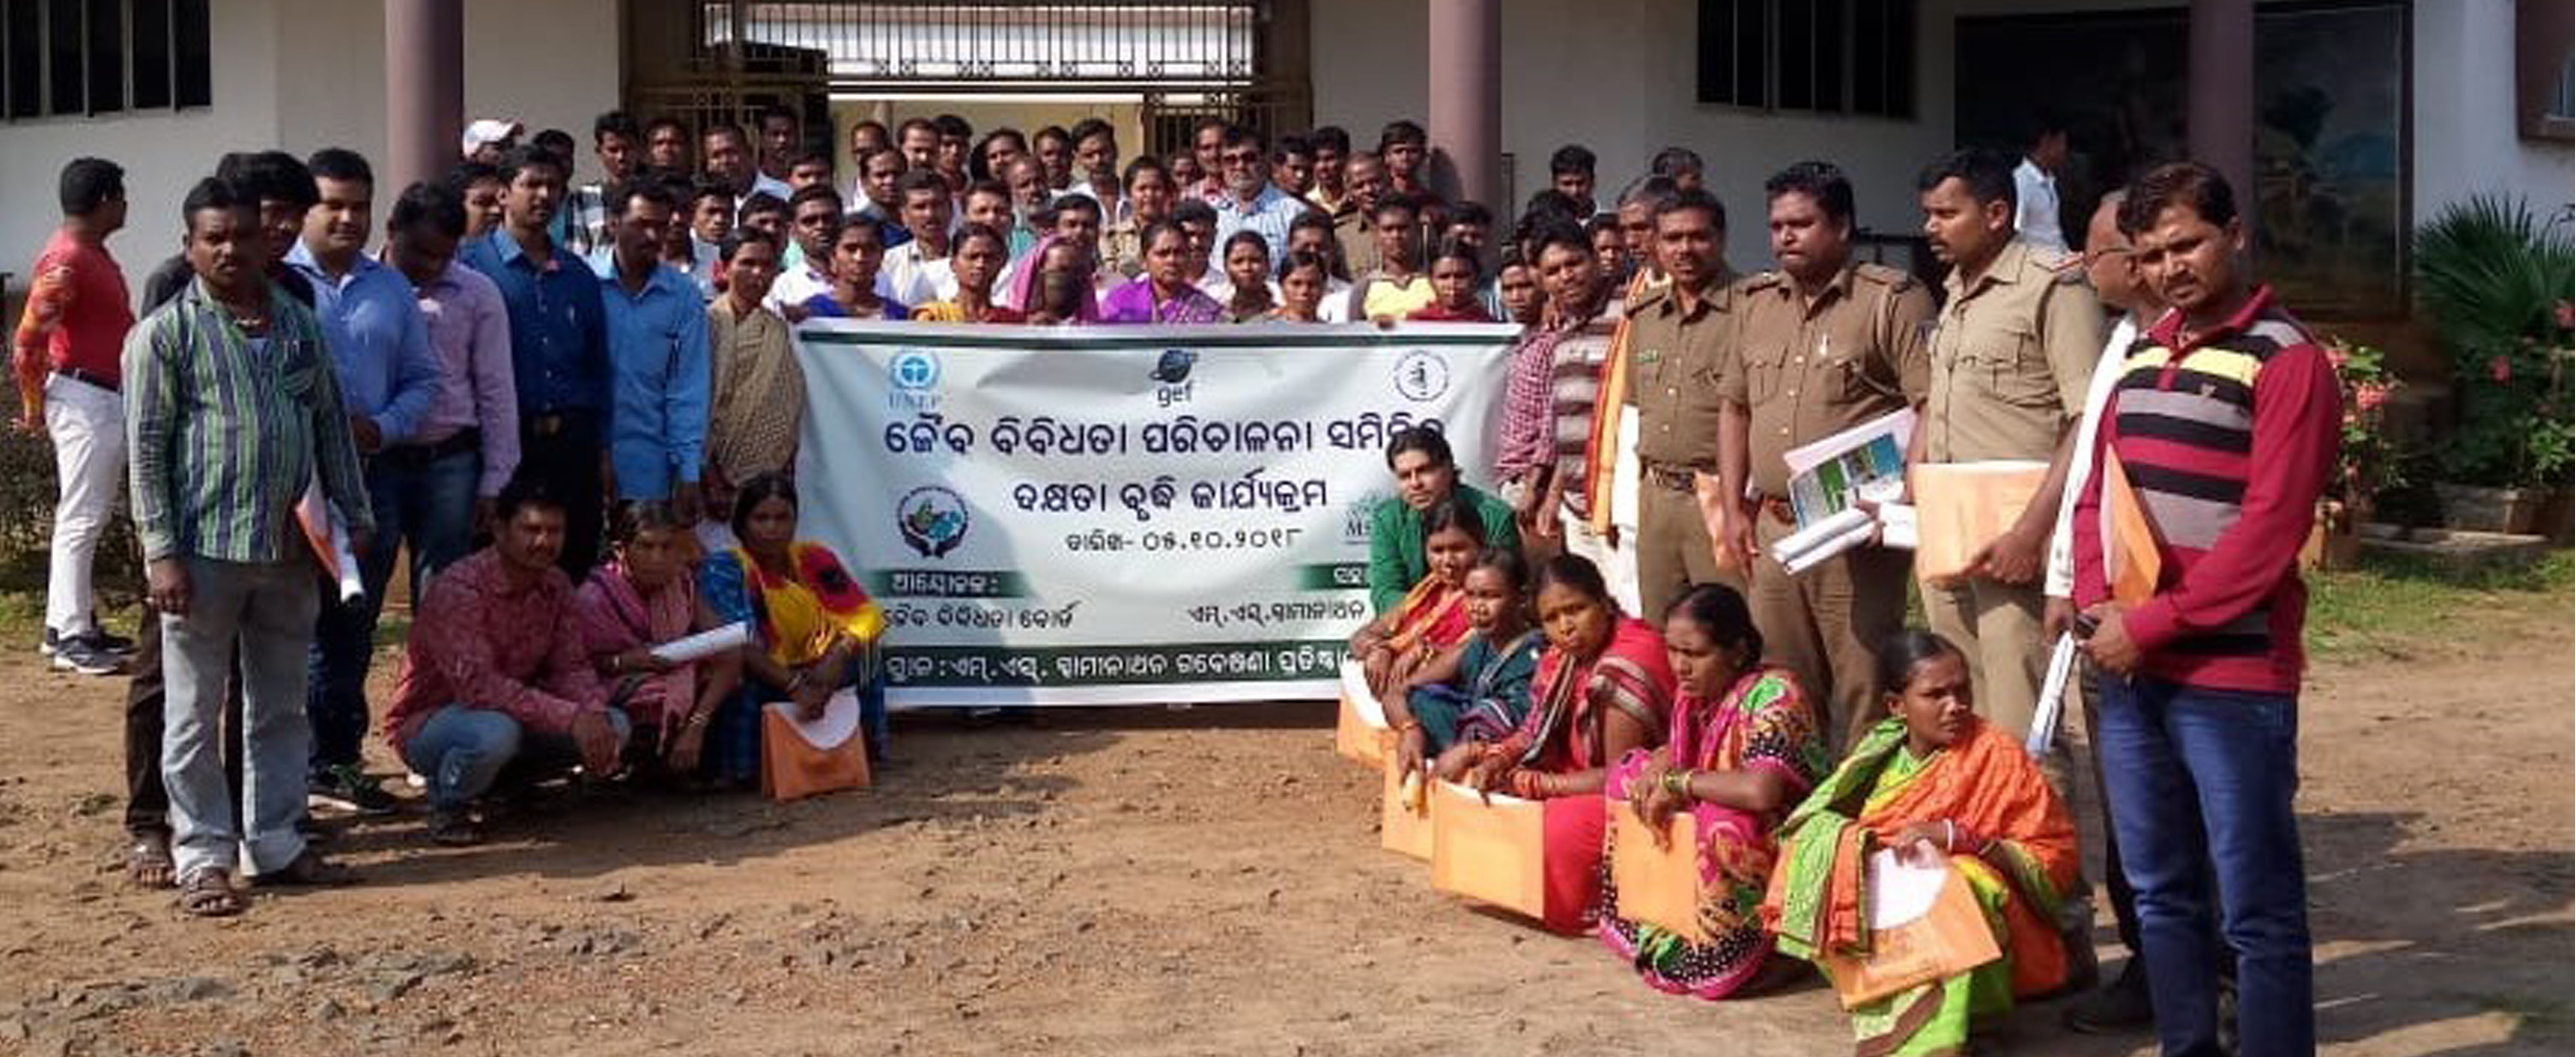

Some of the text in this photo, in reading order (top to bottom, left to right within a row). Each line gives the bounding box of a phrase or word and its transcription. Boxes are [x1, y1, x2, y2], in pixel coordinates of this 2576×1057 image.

[885, 412, 975, 455] ଜୈବ
[991, 417, 1127, 455] ବିବିଧତା
[1142, 415, 1312, 453] ପରିଚାଳନା
[1014, 482, 1106, 512] ଦକ୍ଷତା
[1121, 475, 1176, 521] ବୃଦ୍ଧି
[1191, 468, 1327, 512] କାର୍ଯ୍ୟକ୍ରମ
[1021, 600, 1082, 628] ବୋର୍ଡ
